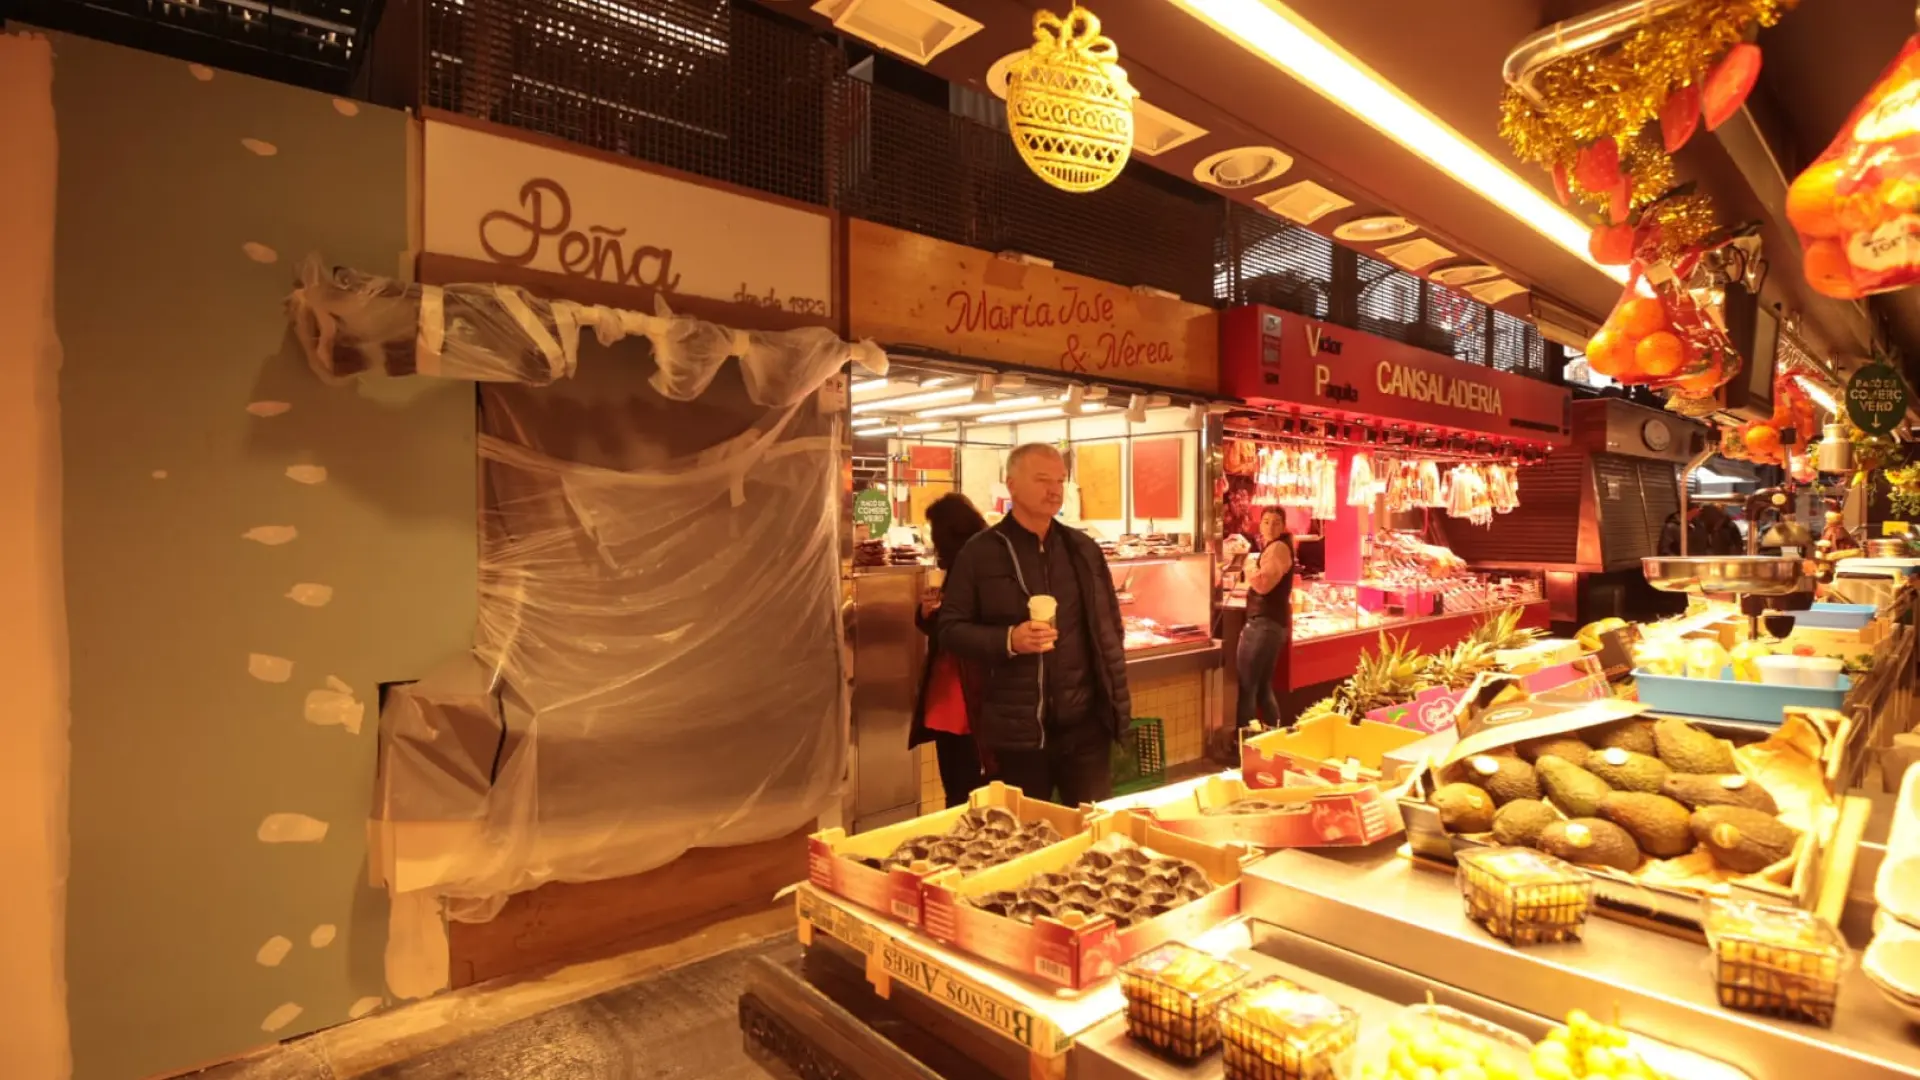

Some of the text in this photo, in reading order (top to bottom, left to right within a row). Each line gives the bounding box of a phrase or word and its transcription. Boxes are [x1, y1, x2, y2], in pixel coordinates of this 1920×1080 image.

[479, 177, 681, 293] Peña
[1058, 286, 1114, 325] Jose
[1060, 330, 1174, 374] & Nerea
[1376, 360, 1503, 417] CANSALADERIA
[882, 945, 1034, 1048] BUENOS AIRES
